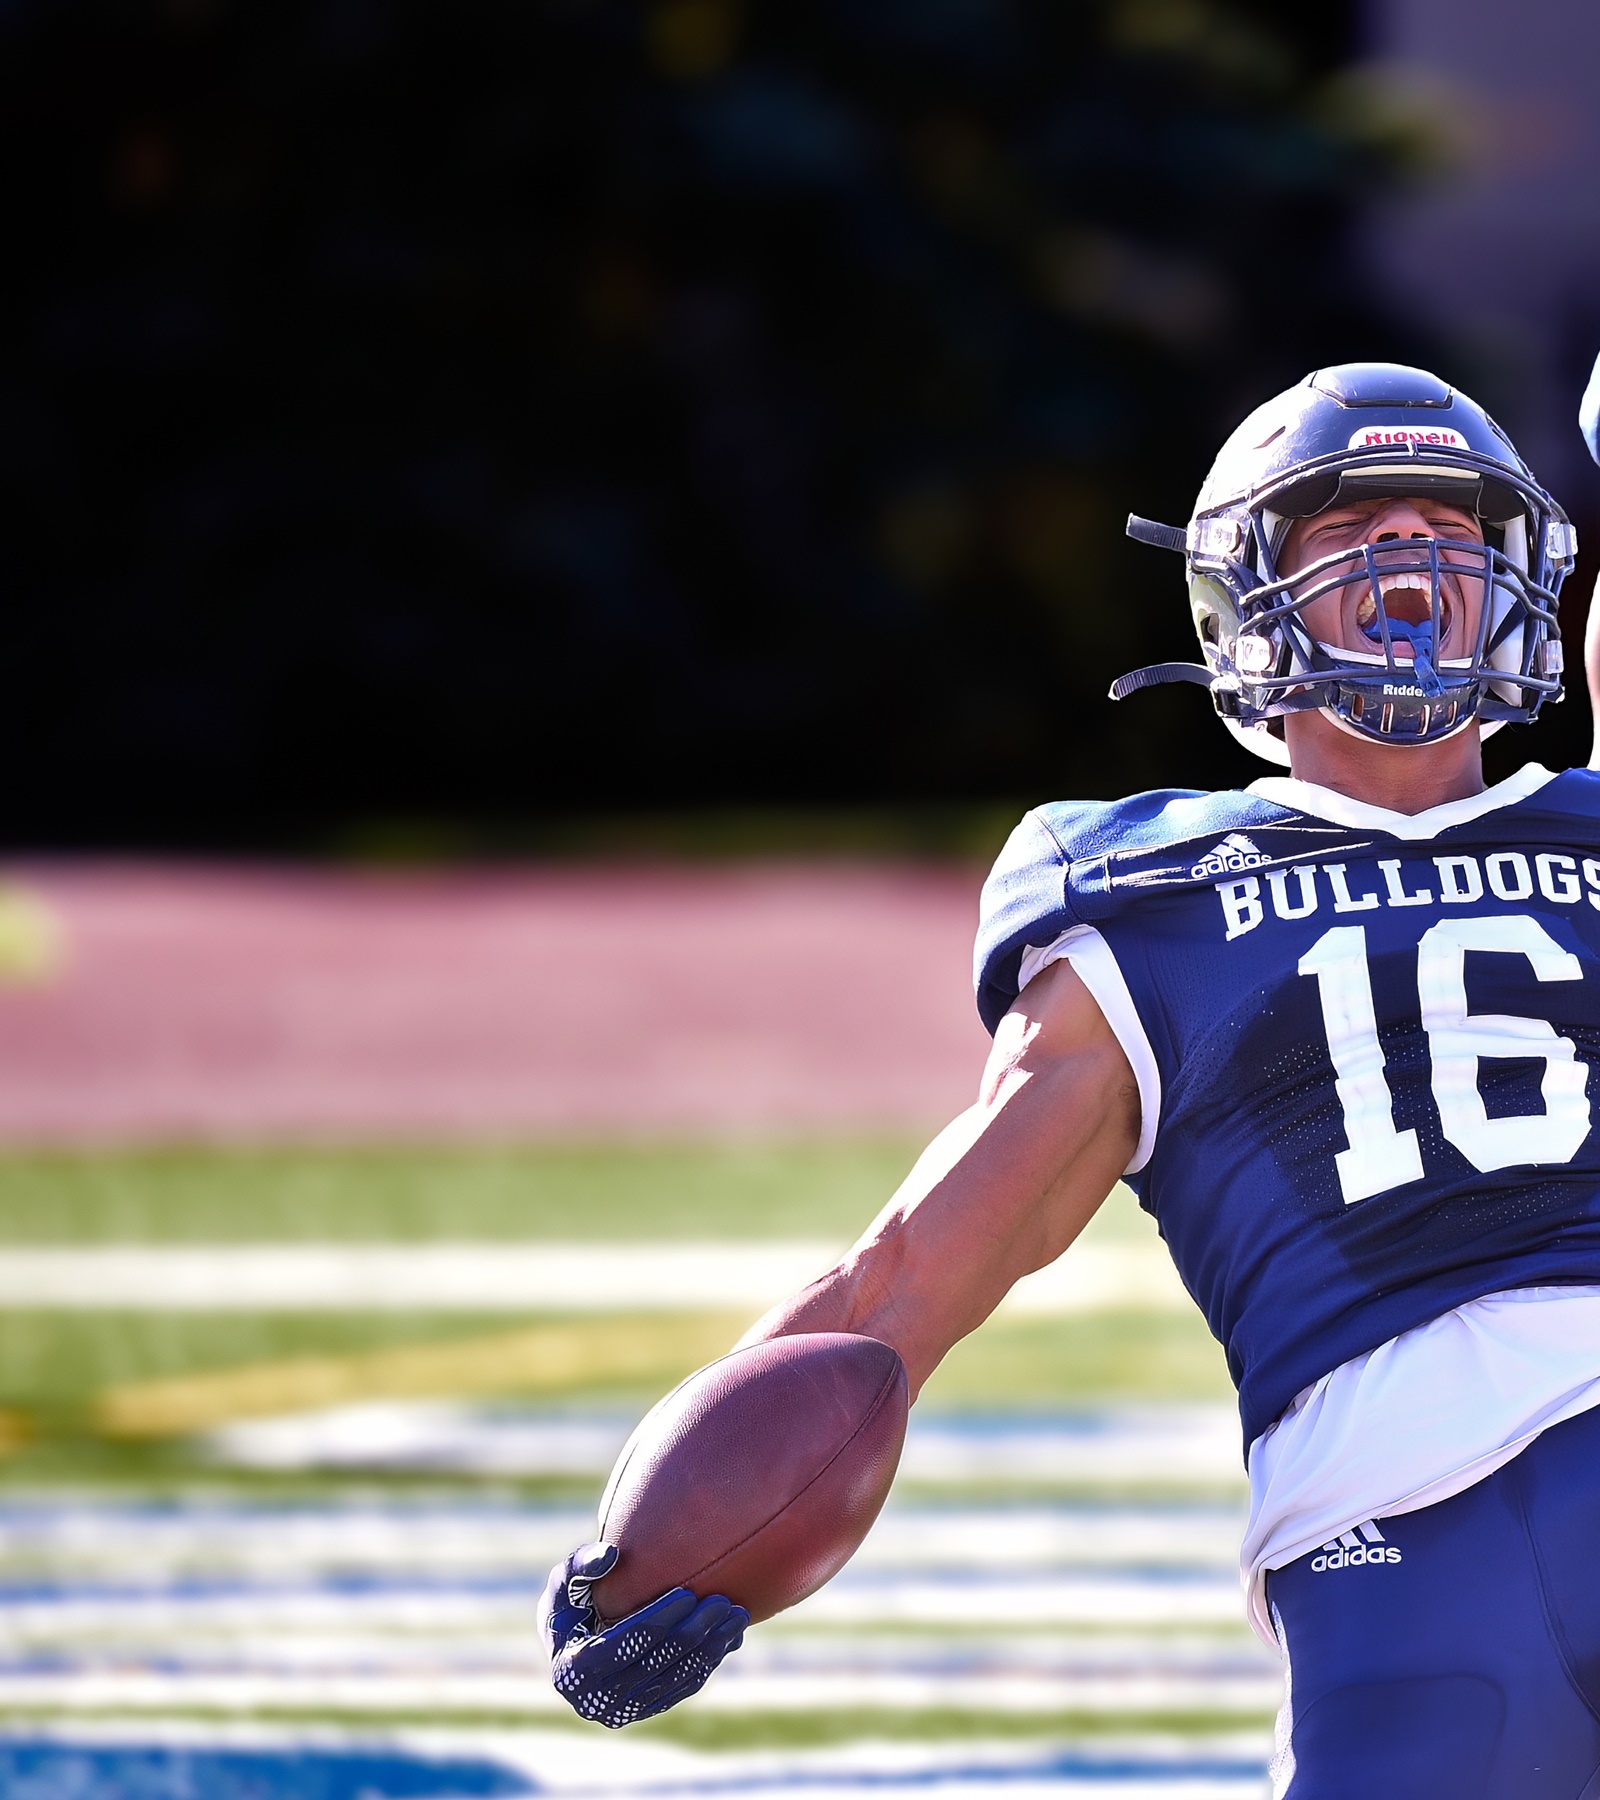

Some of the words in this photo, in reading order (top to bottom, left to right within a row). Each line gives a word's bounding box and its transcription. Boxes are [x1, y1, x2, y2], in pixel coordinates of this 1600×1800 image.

[1383, 684, 1427, 698] Ridde
[1190, 852, 1273, 879] adidas
[1298, 915, 1593, 1205] 16
[1311, 1544, 1402, 1573] adidas
